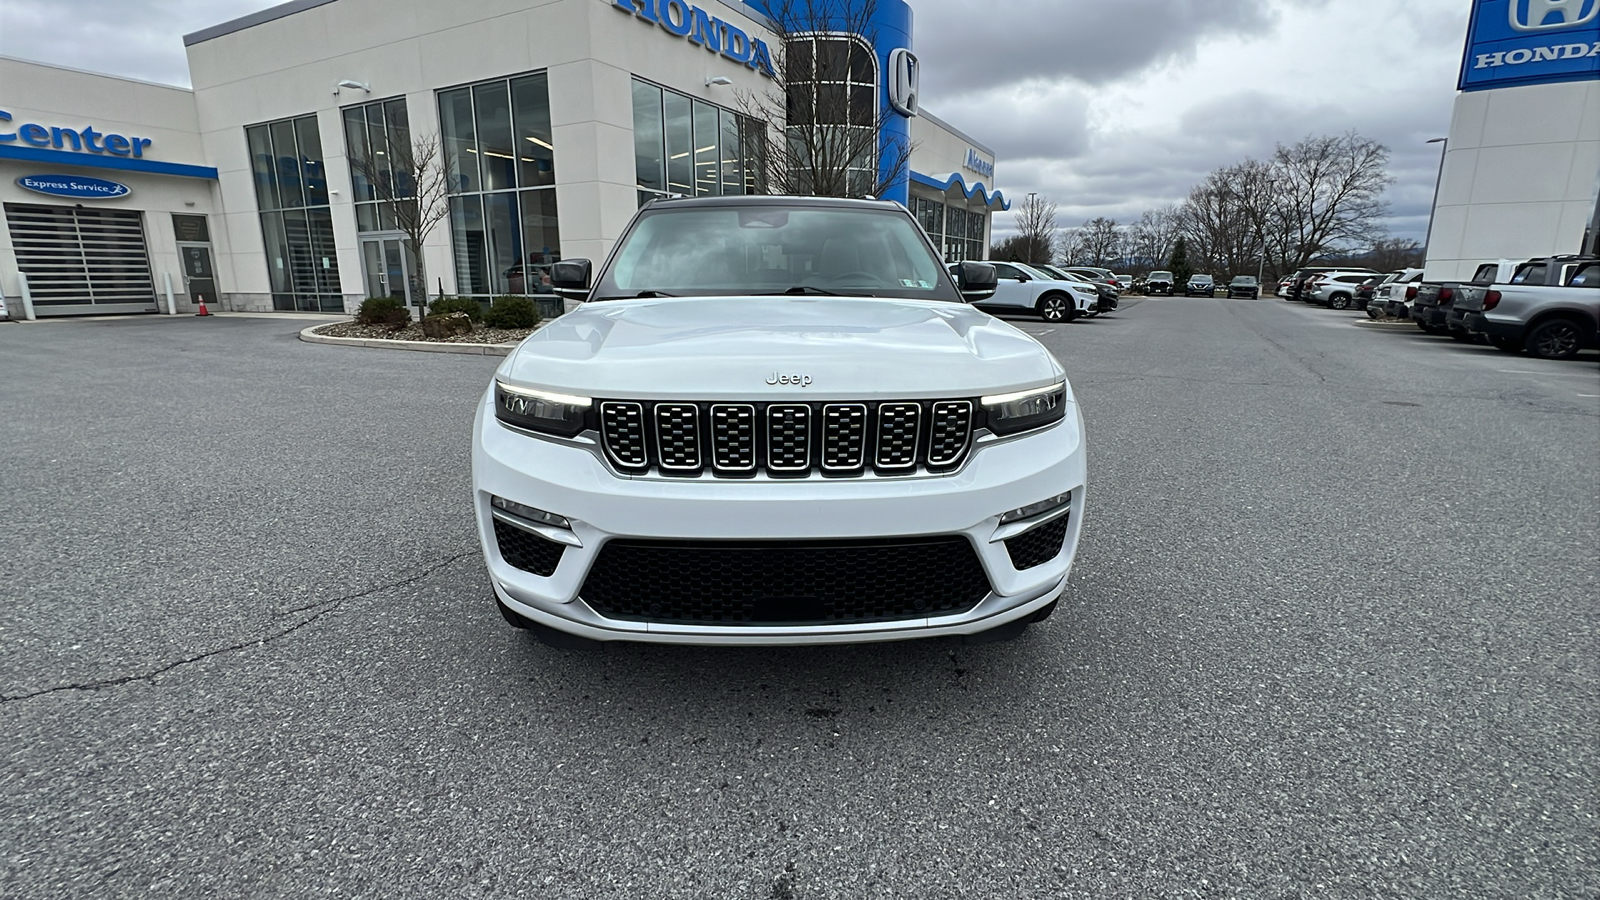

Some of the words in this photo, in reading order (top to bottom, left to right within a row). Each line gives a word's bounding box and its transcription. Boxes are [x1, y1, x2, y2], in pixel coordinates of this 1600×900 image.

[24, 178, 68, 189] Express
[69, 182, 109, 192] Service
[765, 370, 813, 387] Jeep
